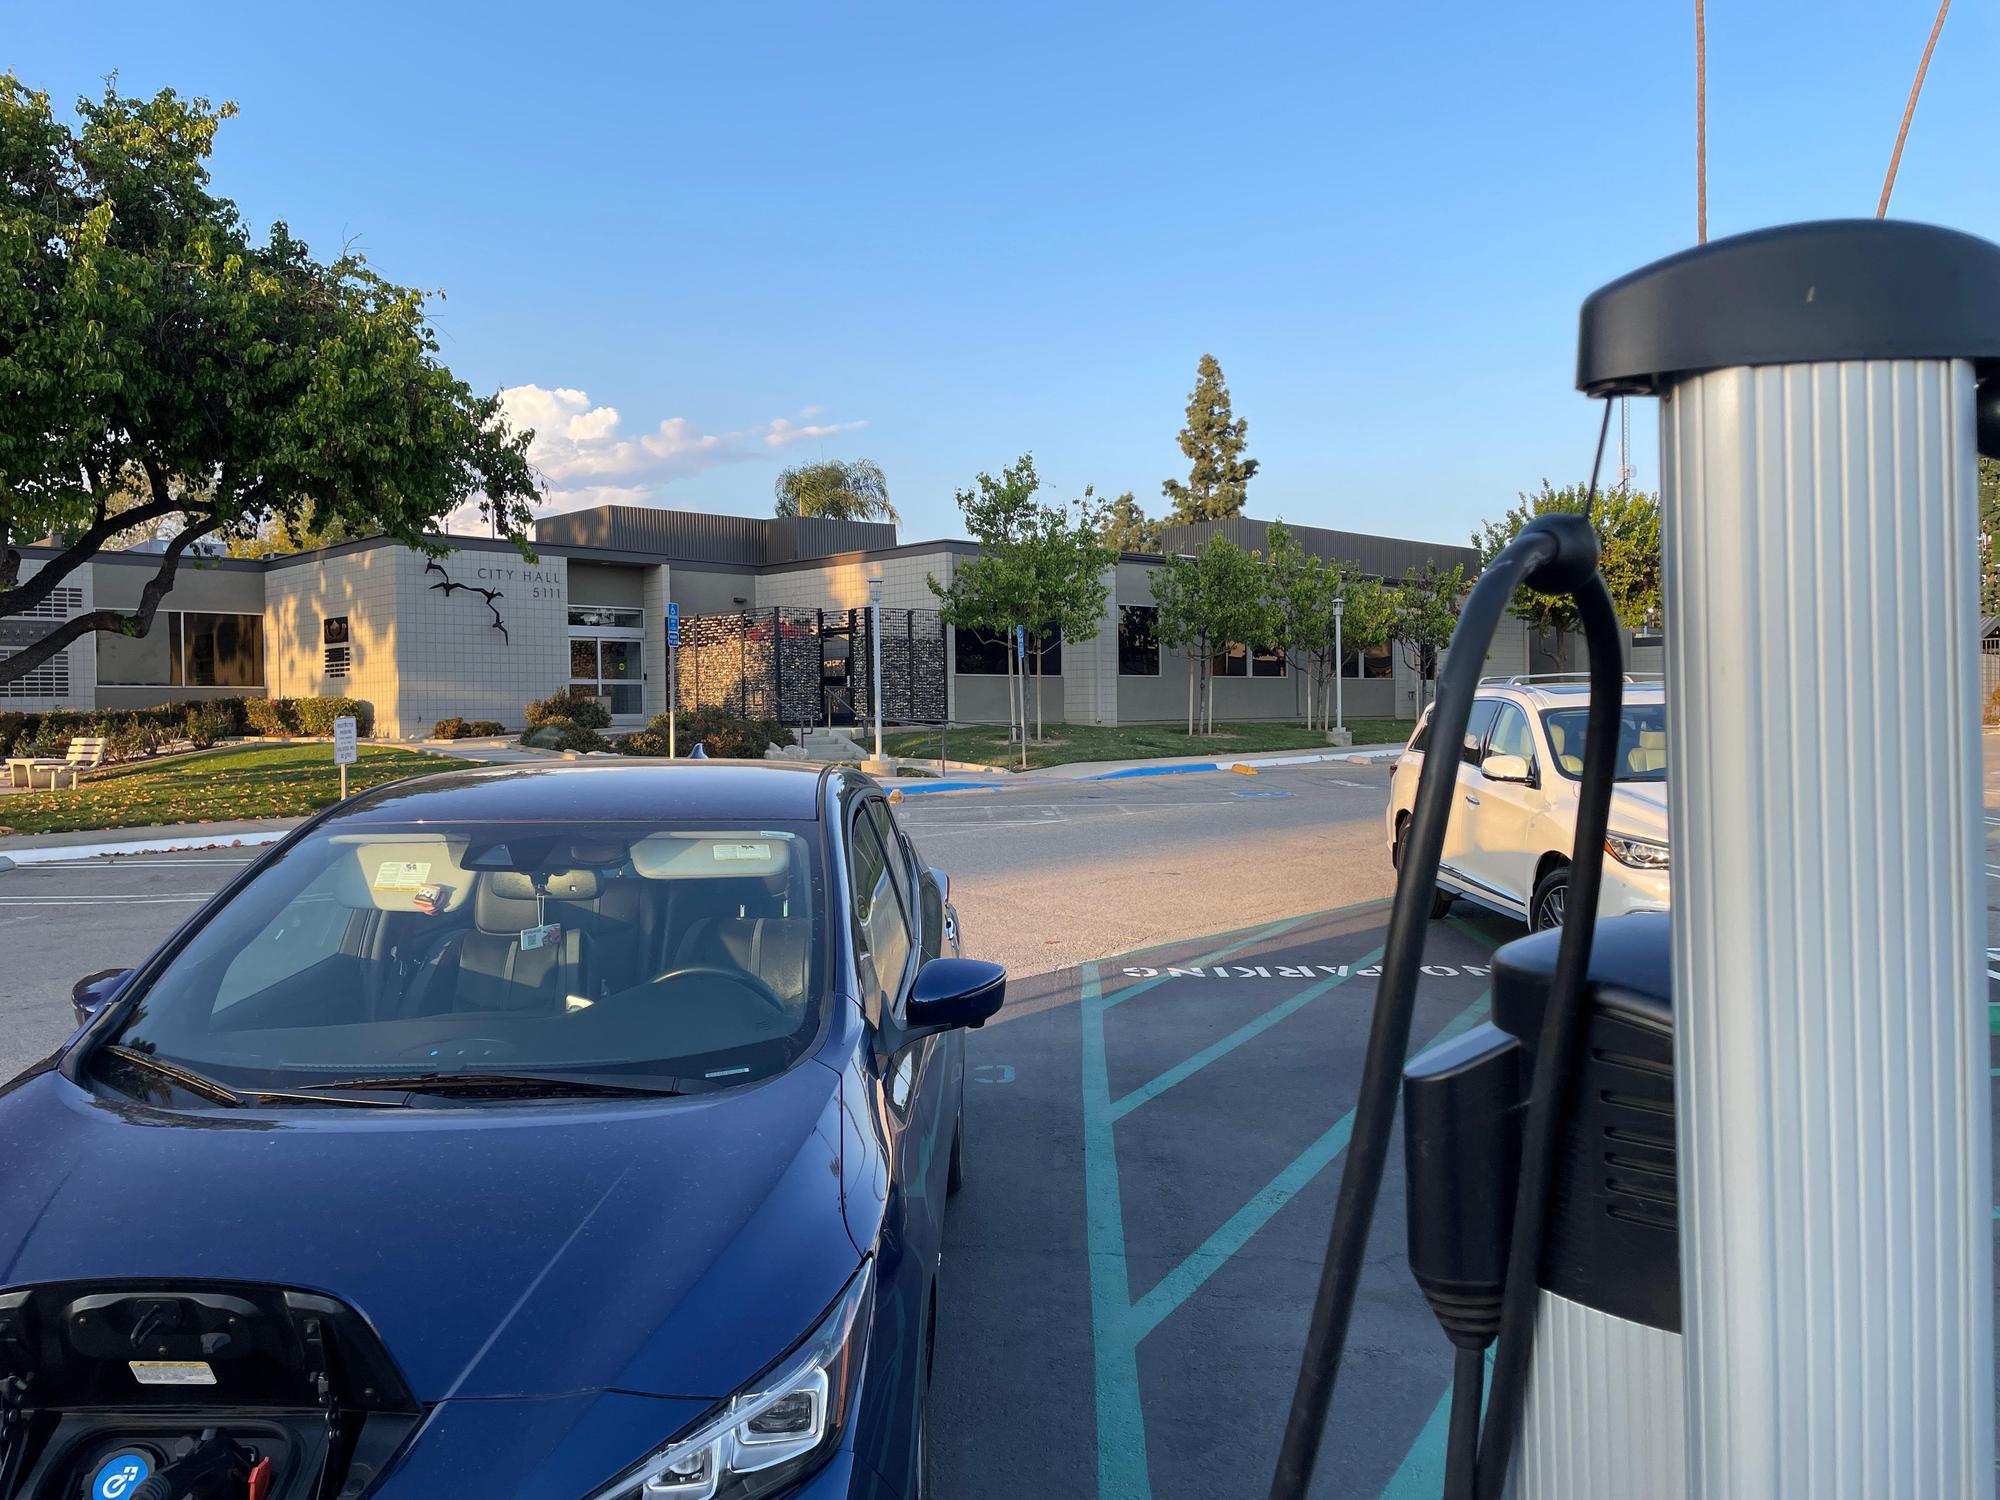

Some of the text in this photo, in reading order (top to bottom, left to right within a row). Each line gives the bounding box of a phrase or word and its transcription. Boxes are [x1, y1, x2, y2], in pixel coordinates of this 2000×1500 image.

[477, 568, 560, 583] CITY HALL
[533, 587, 560, 599] 5111
